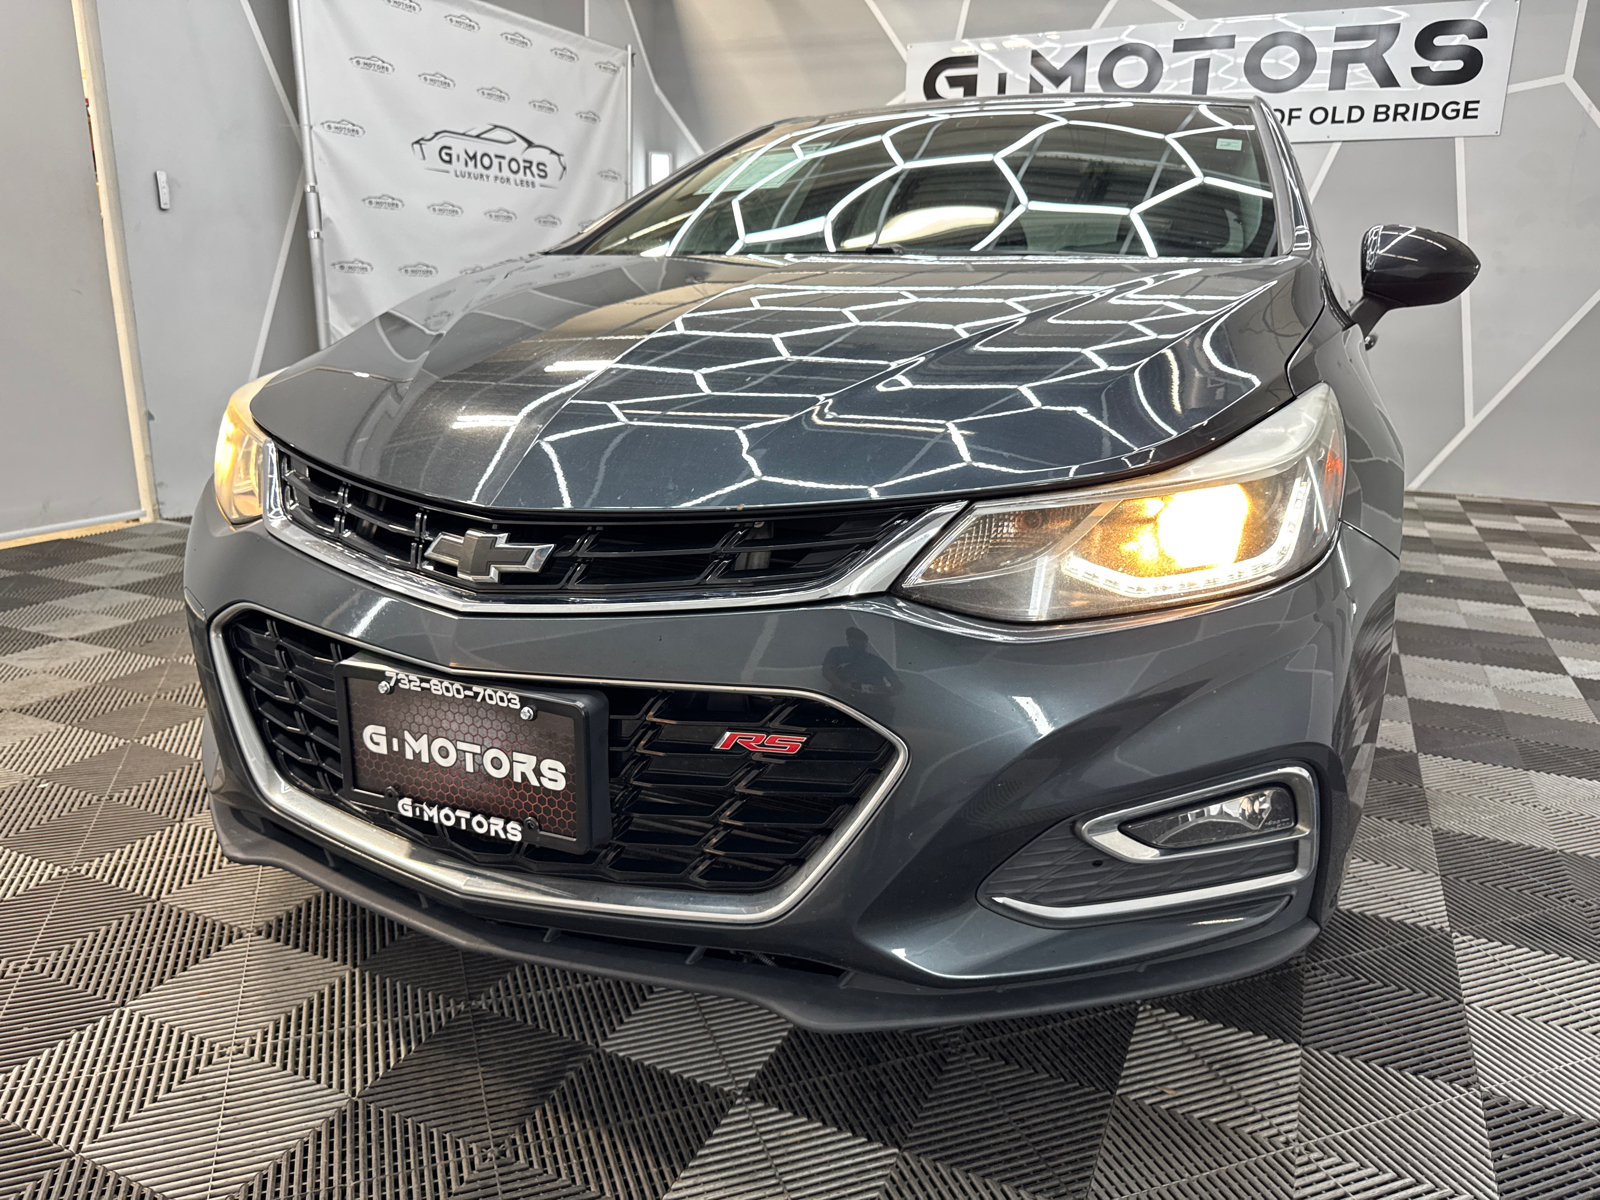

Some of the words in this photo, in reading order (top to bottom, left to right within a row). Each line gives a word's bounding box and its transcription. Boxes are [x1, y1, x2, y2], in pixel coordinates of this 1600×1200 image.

[1309, 105, 1365, 125] OLD
[1373, 100, 1480, 123] BRIDGE
[454, 169, 490, 183] LUXURY
[494, 175, 511, 186] FOR
[514, 179, 536, 189] LESS
[385, 671, 521, 709] 732-800-7003
[714, 731, 807, 754] RS
